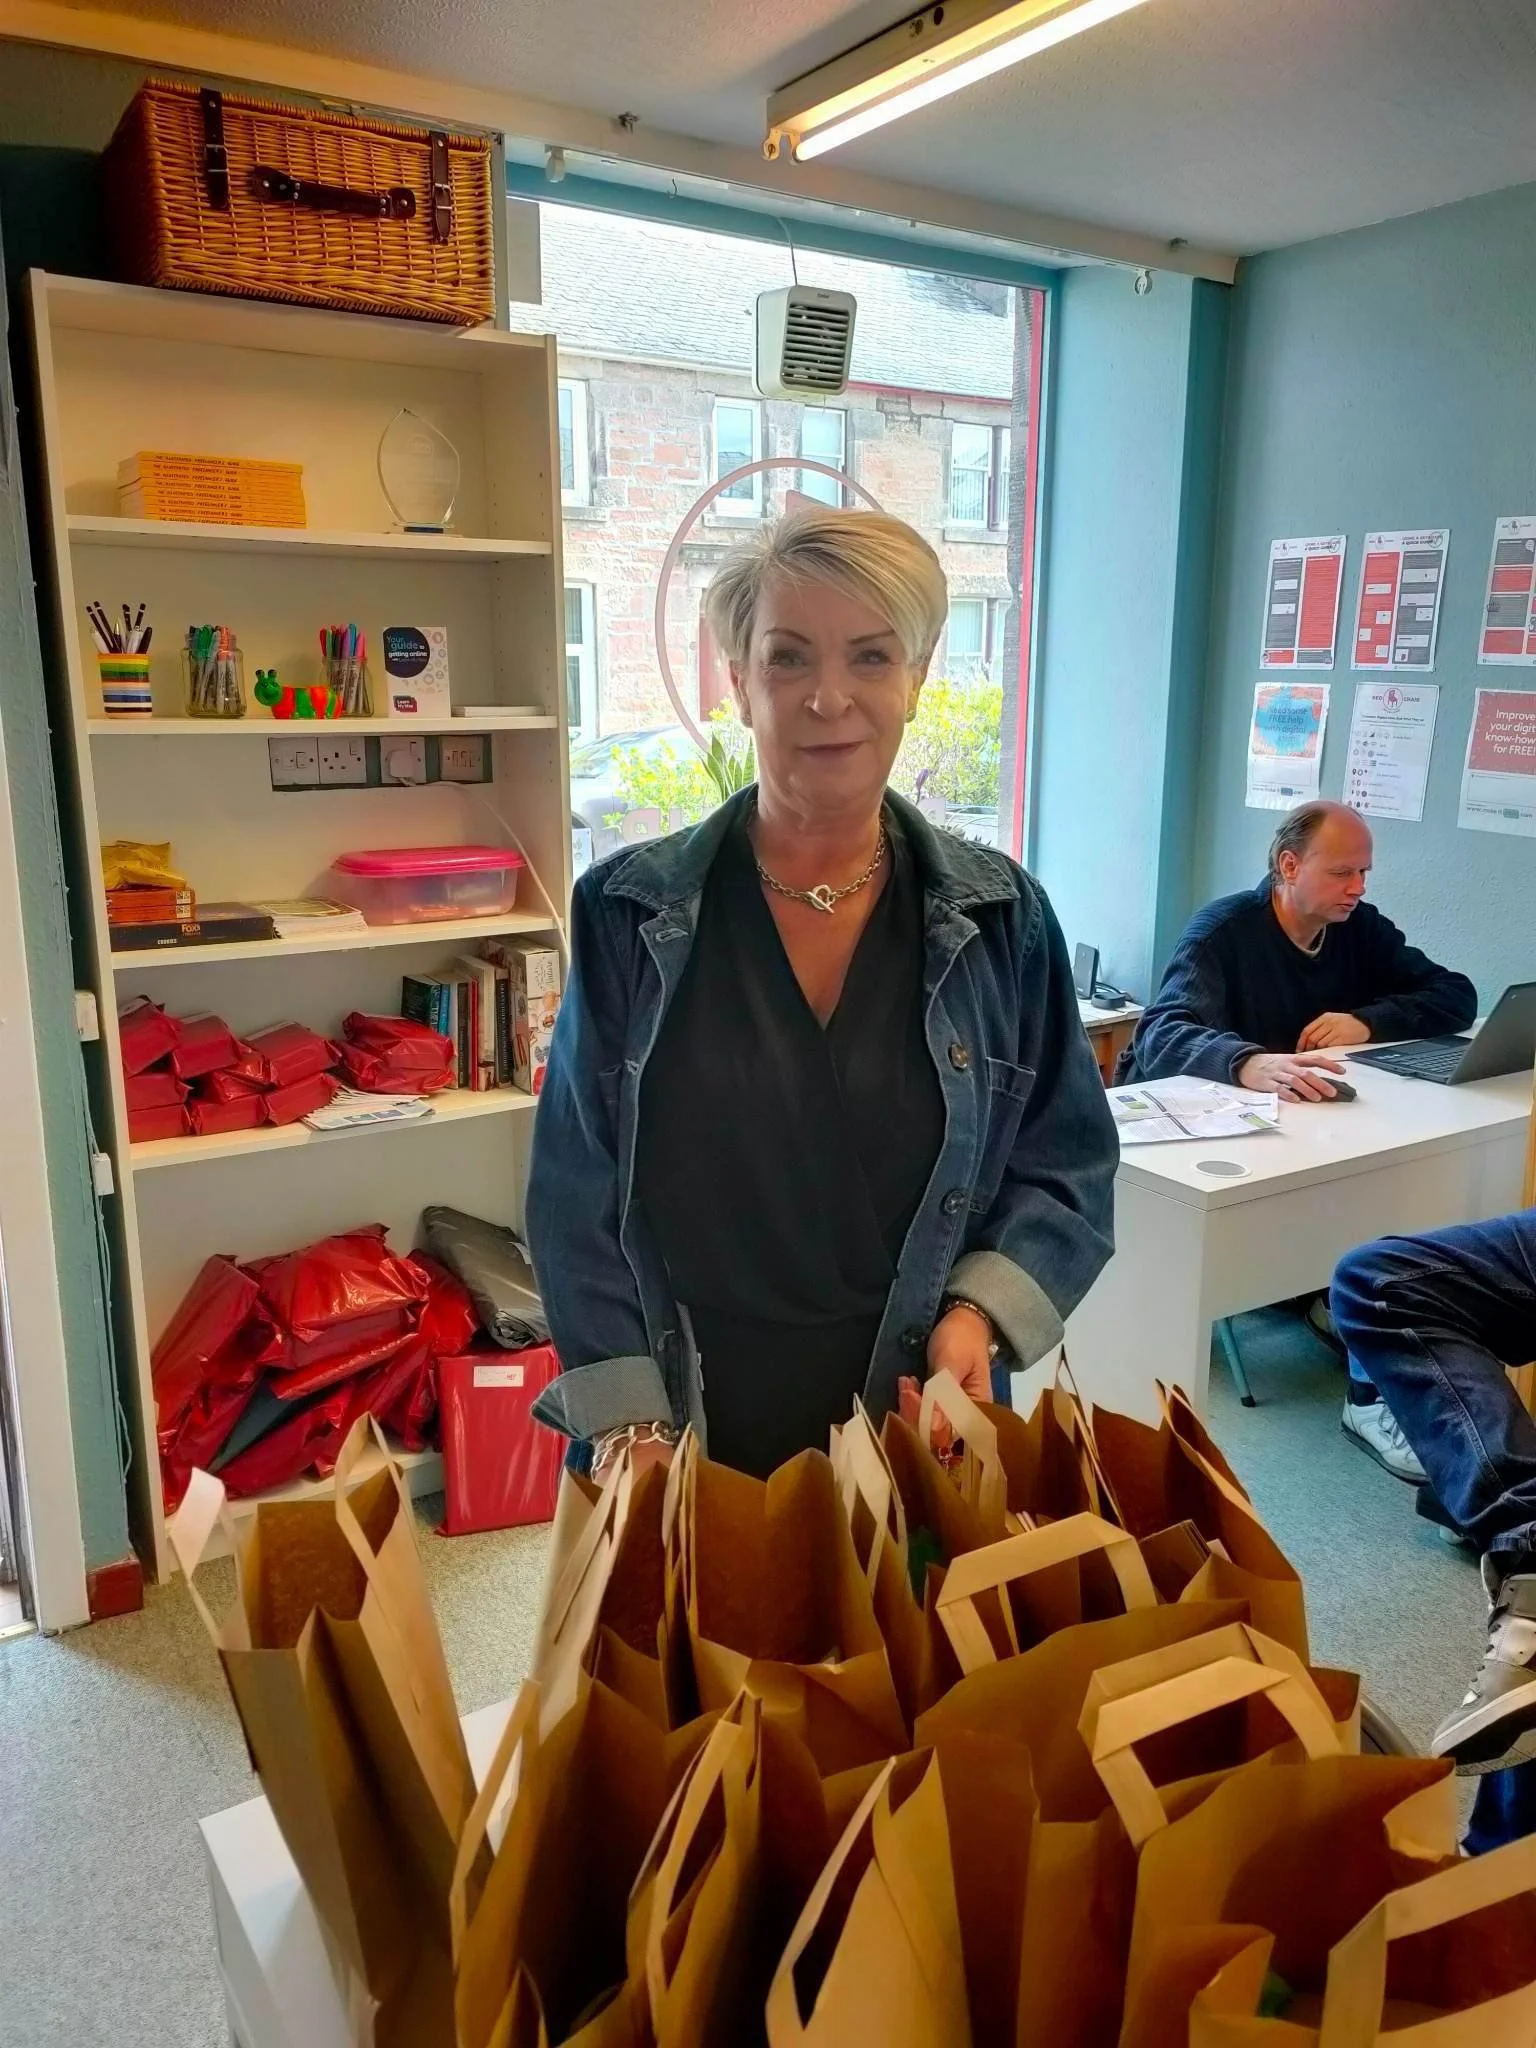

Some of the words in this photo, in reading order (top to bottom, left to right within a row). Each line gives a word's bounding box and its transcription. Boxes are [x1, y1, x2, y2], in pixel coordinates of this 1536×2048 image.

[390, 641, 418, 651] guide
[1496, 709, 1536, 722] Improve
[1490, 721, 1513, 732] your
[1484, 731, 1536, 744] know-how
[1493, 744, 1508, 754] for
[1508, 745, 1536, 757] FREE!
